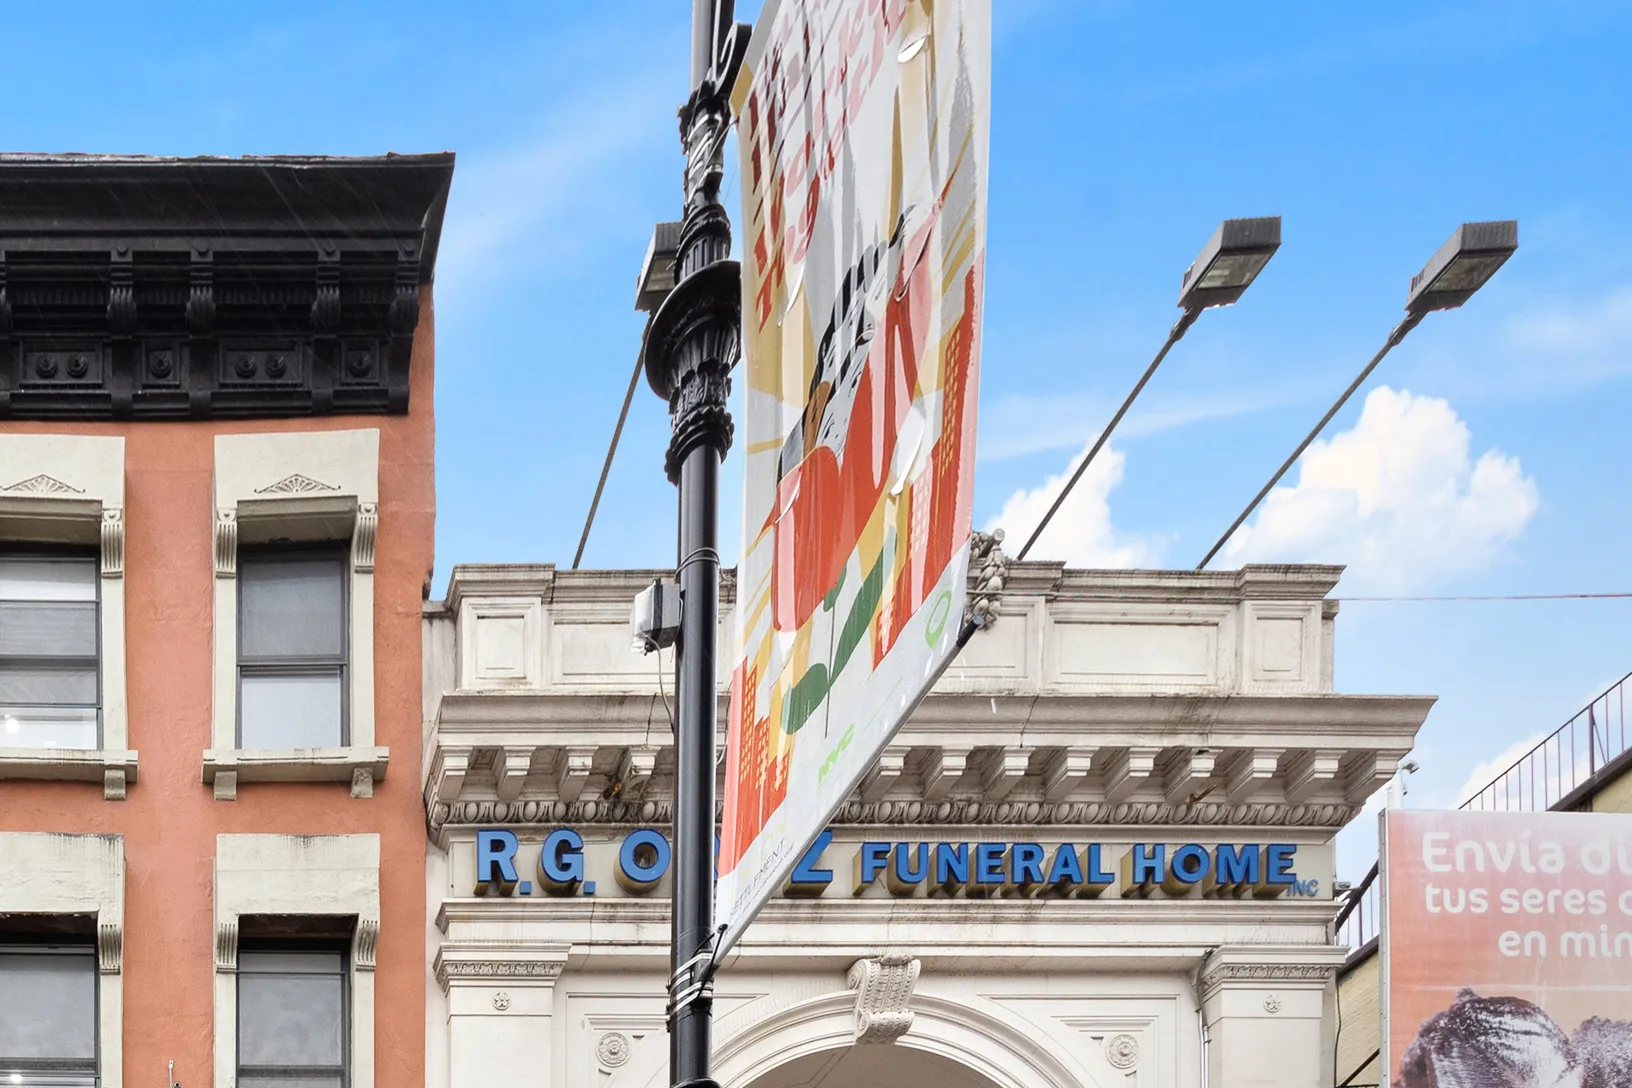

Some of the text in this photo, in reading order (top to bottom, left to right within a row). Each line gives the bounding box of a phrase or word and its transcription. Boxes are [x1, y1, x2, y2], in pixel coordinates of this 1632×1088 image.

[477, 828, 596, 894] R.G.
[862, 841, 1115, 884] FUNERAL
[1133, 842, 1298, 884] HOME
[1422, 829, 1566, 874] Envía
[1425, 882, 1489, 914] tus
[1500, 887, 1607, 916] seres
[1498, 929, 1547, 957] en
